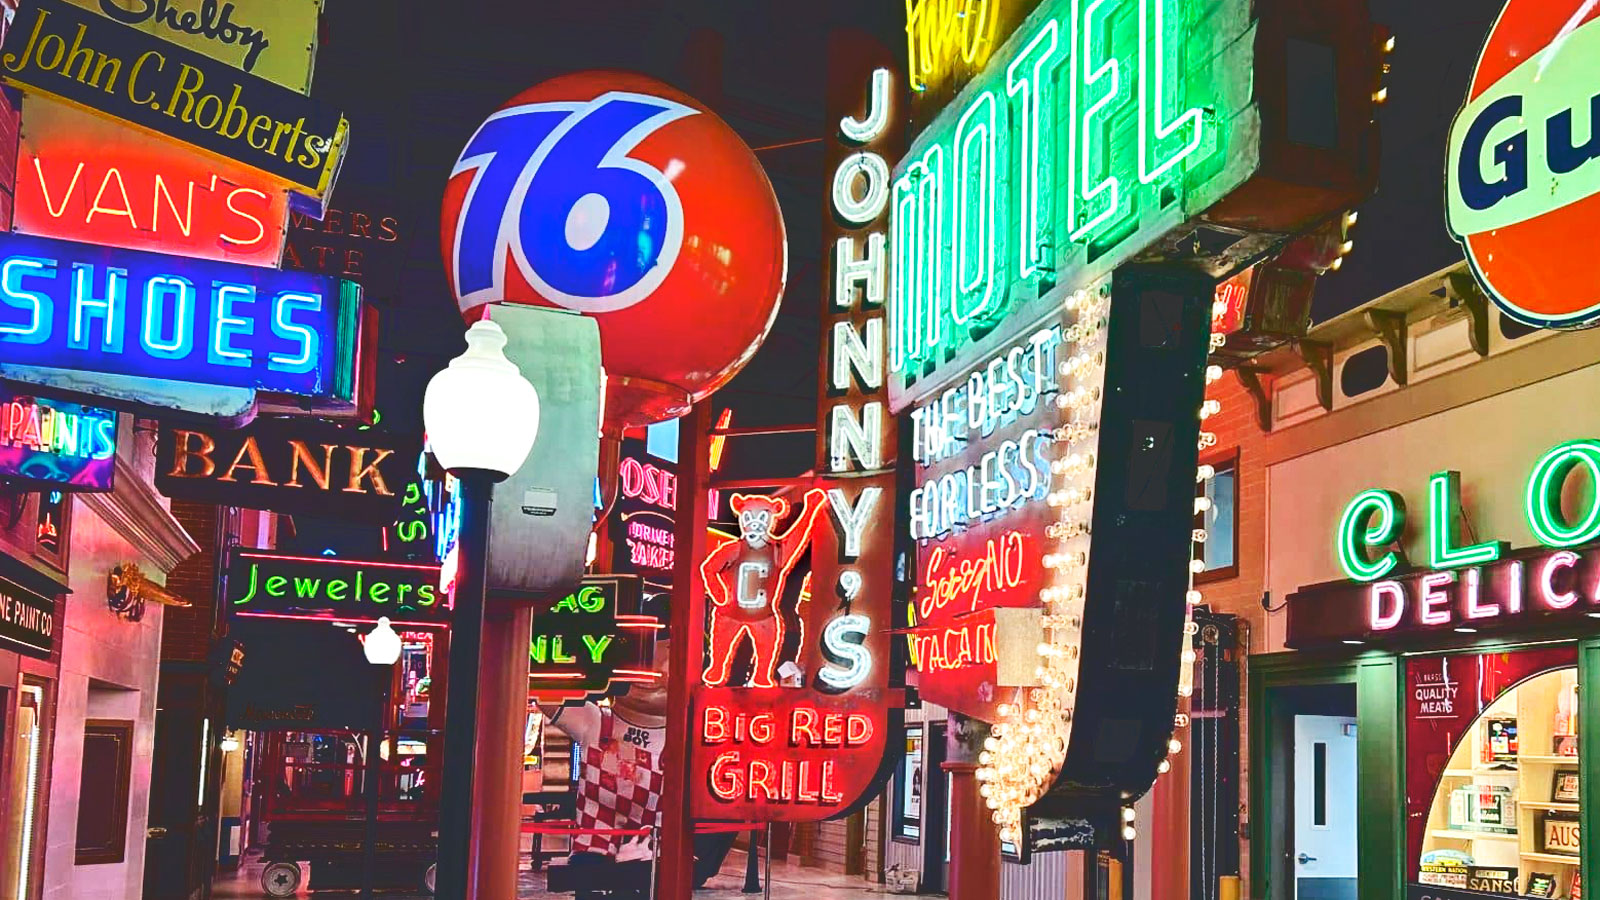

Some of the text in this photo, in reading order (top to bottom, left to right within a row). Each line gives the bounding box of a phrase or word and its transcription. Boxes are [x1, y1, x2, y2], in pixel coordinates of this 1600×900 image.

[2, 8, 331, 170] John C. Roberts
[34, 156, 267, 246] VAN'S
[449, 91, 702, 313] 76
[890, 0, 1210, 373] MOTEL
[0, 254, 322, 374] SHOES
[909, 327, 1060, 464] THE BEST
[167, 428, 395, 497] BANK
[909, 429, 1052, 541] FOR LESS
[234, 563, 436, 607] Jewelers
[736, 561, 768, 609] C
[987, 531, 1023, 592] NO
[1370, 550, 1600, 631] DELIC
[14, 600, 41, 632] PAINT
[41, 611, 53, 637] CO
[791, 707, 874, 745] RED
[1415, 686, 1458, 701] QUALITY
[1419, 701, 1453, 714] MEATS
[623, 733, 651, 749] BOY
[709, 750, 844, 803] GRILL
